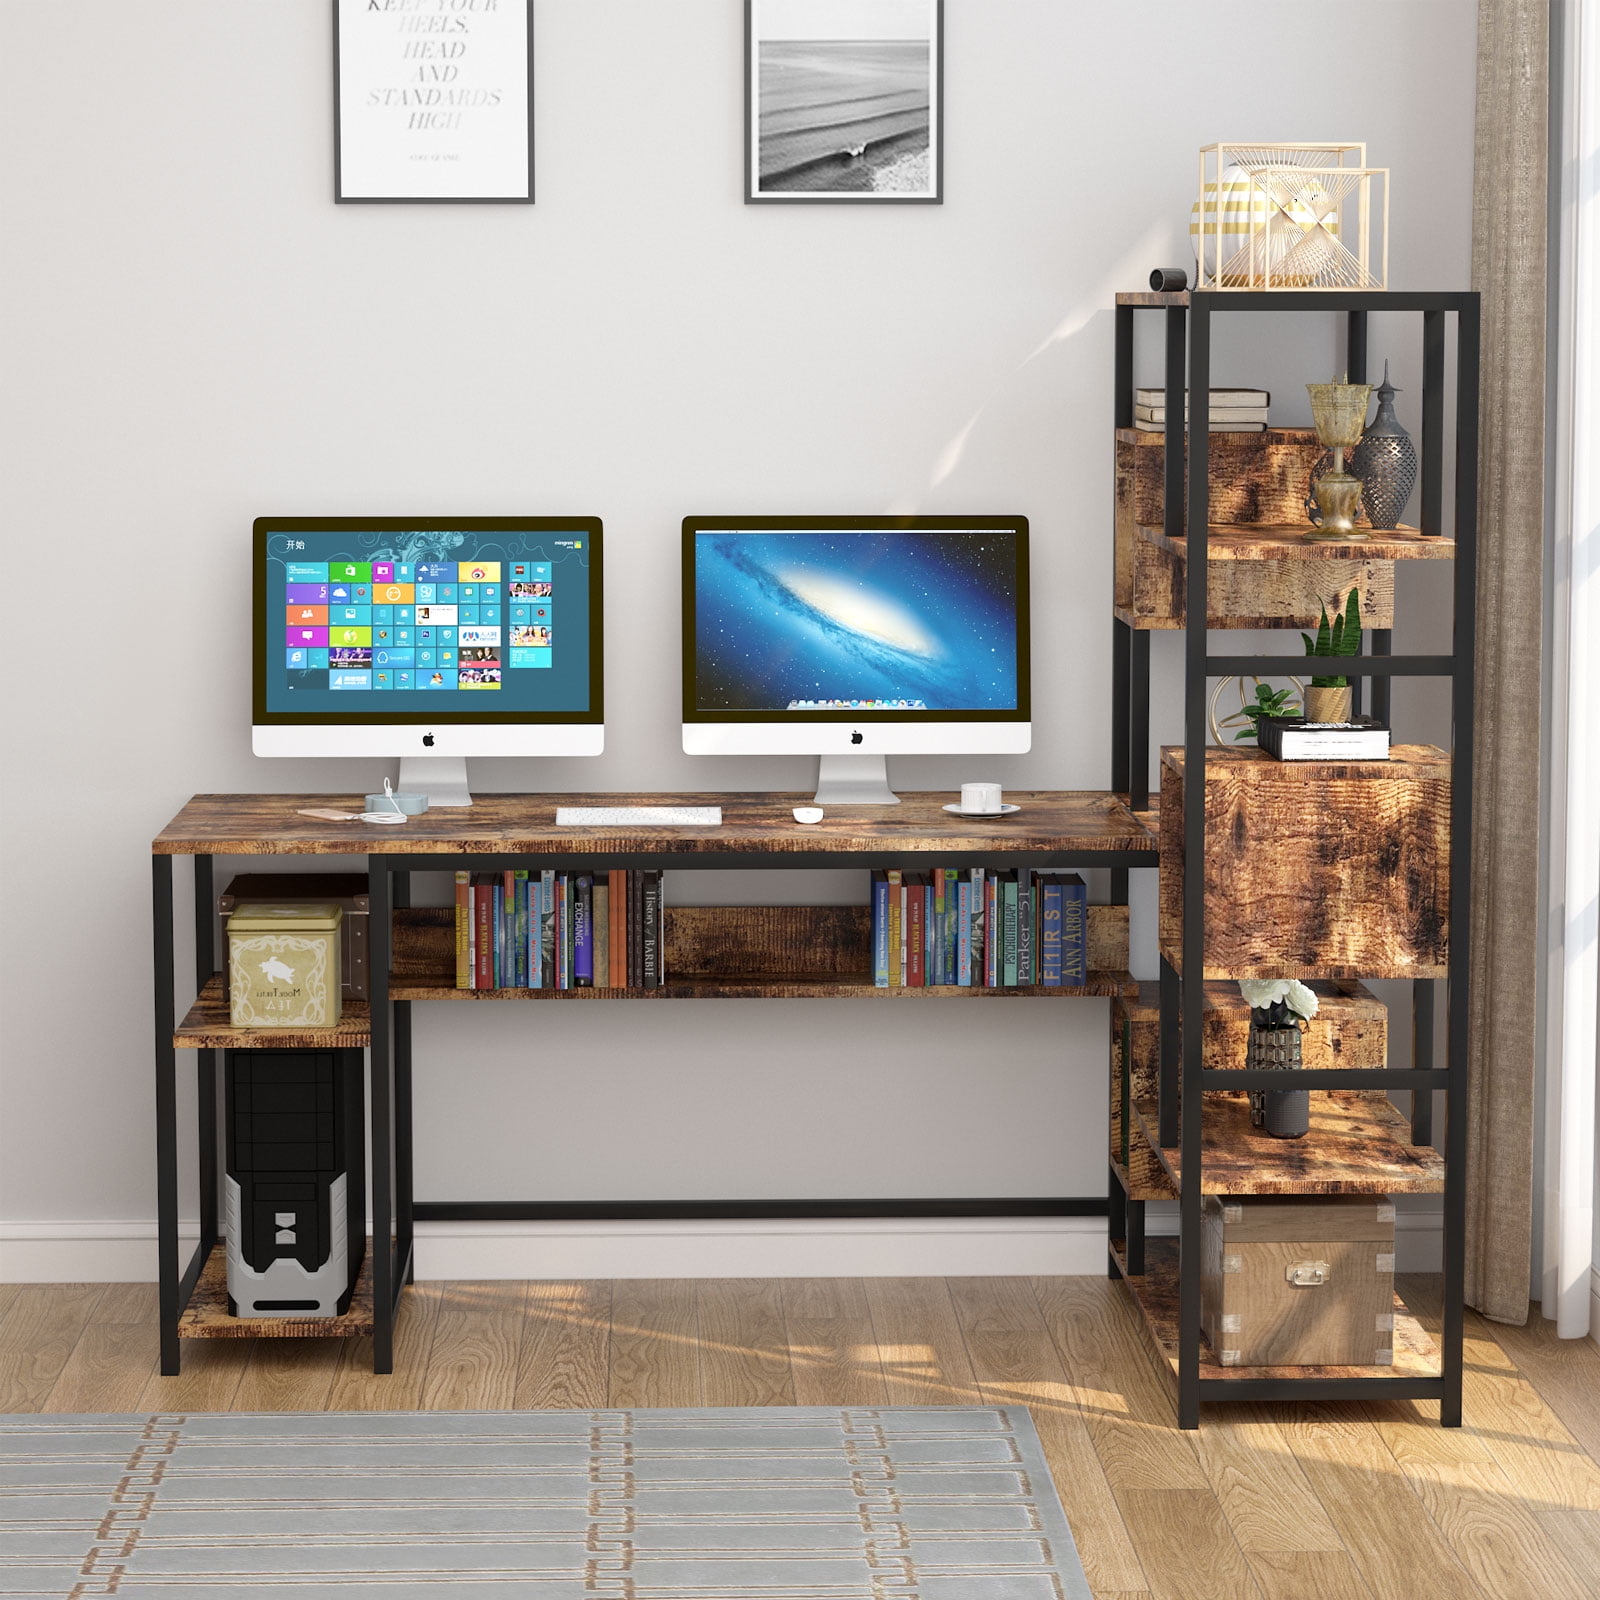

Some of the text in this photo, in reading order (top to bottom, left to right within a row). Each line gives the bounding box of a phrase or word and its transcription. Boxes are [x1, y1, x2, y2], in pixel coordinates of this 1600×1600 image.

[403, 41, 467, 59] HEAD
[410, 65, 459, 82] AND
[366, 88, 503, 107] STANDARDS
[408, 112, 463, 130] HIGH
[286, 540, 305, 550] 开始
[320, 586, 327, 596] 5
[575, 902, 584, 947] EXCHANGE
[644, 891, 656, 977] History of BARBIE
[1005, 902, 1016, 965] PSYCHOTHERAPY
[1062, 899, 1082, 979] ANN ARBOR
[1018, 924, 1030, 980] Parker
